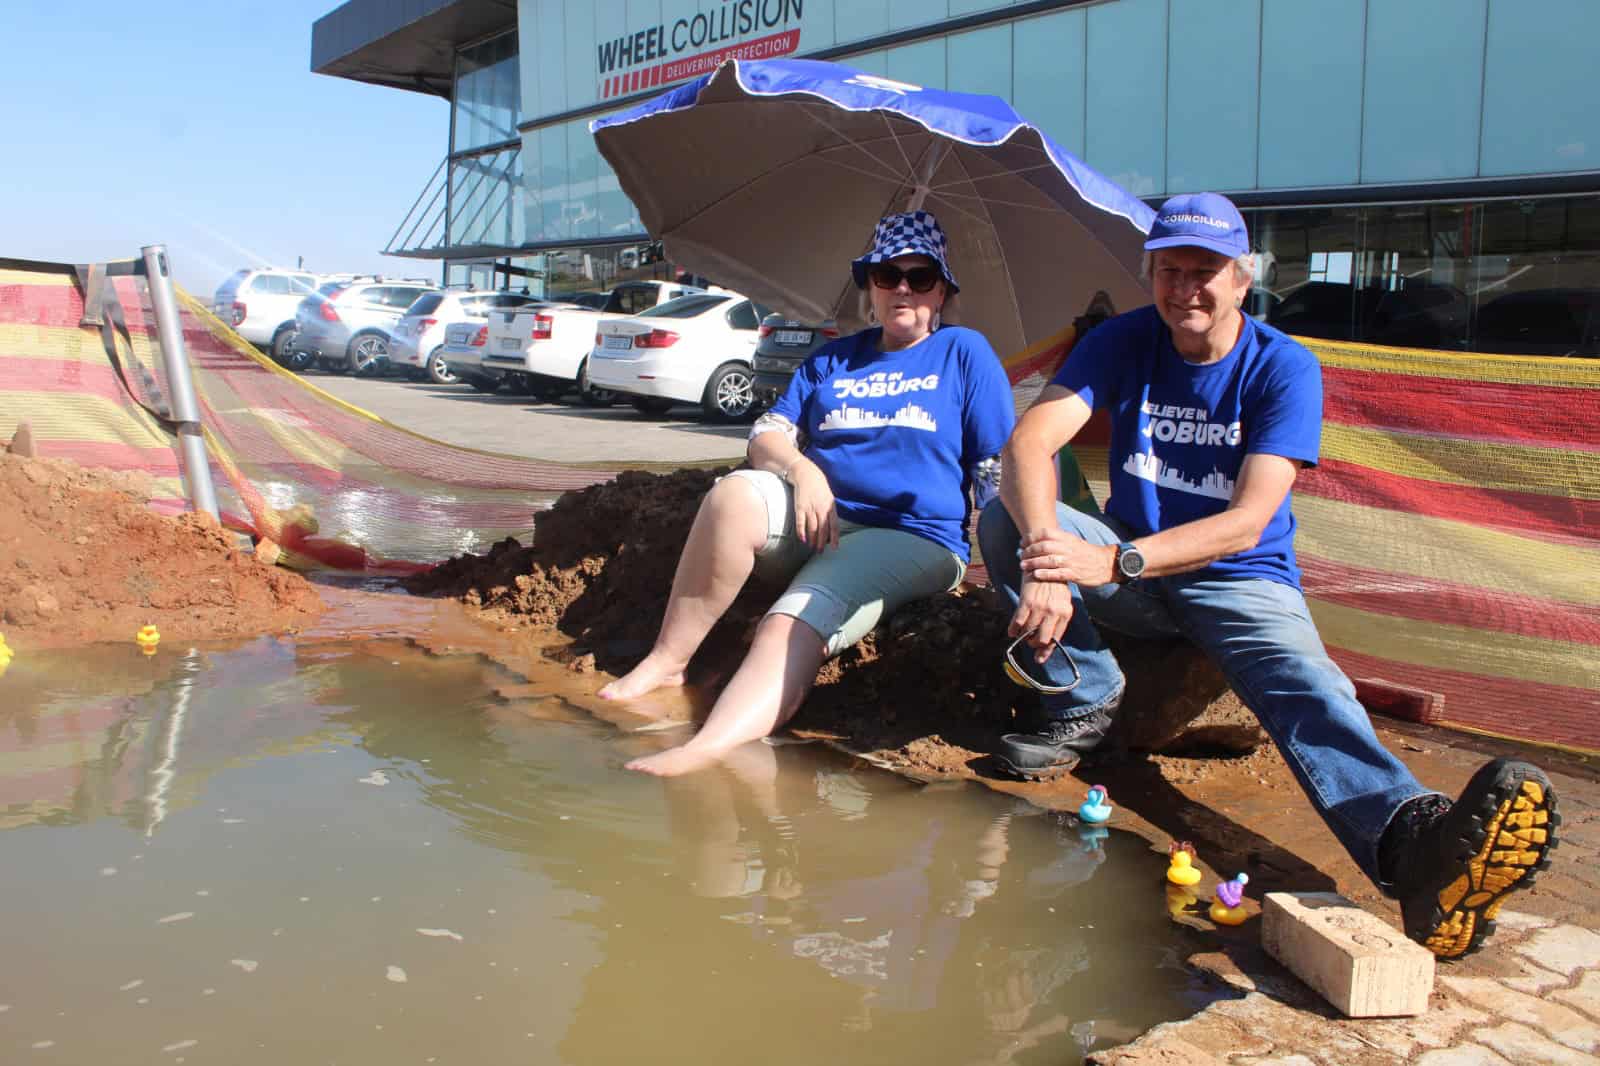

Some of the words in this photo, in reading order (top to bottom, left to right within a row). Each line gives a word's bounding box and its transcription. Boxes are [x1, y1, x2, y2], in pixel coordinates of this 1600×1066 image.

[599, 26, 667, 73] WHEEL
[671, 0, 802, 52] COLLISION
[667, 55, 720, 78] DELIVERING
[725, 36, 790, 60] PERFECTION
[1164, 214, 1230, 229] COUNCILLOR
[832, 374, 939, 399] JOBURG
[1141, 400, 1195, 419] ELIEVE
[1196, 408, 1208, 421] IN
[1142, 417, 1242, 446] JOBURG
